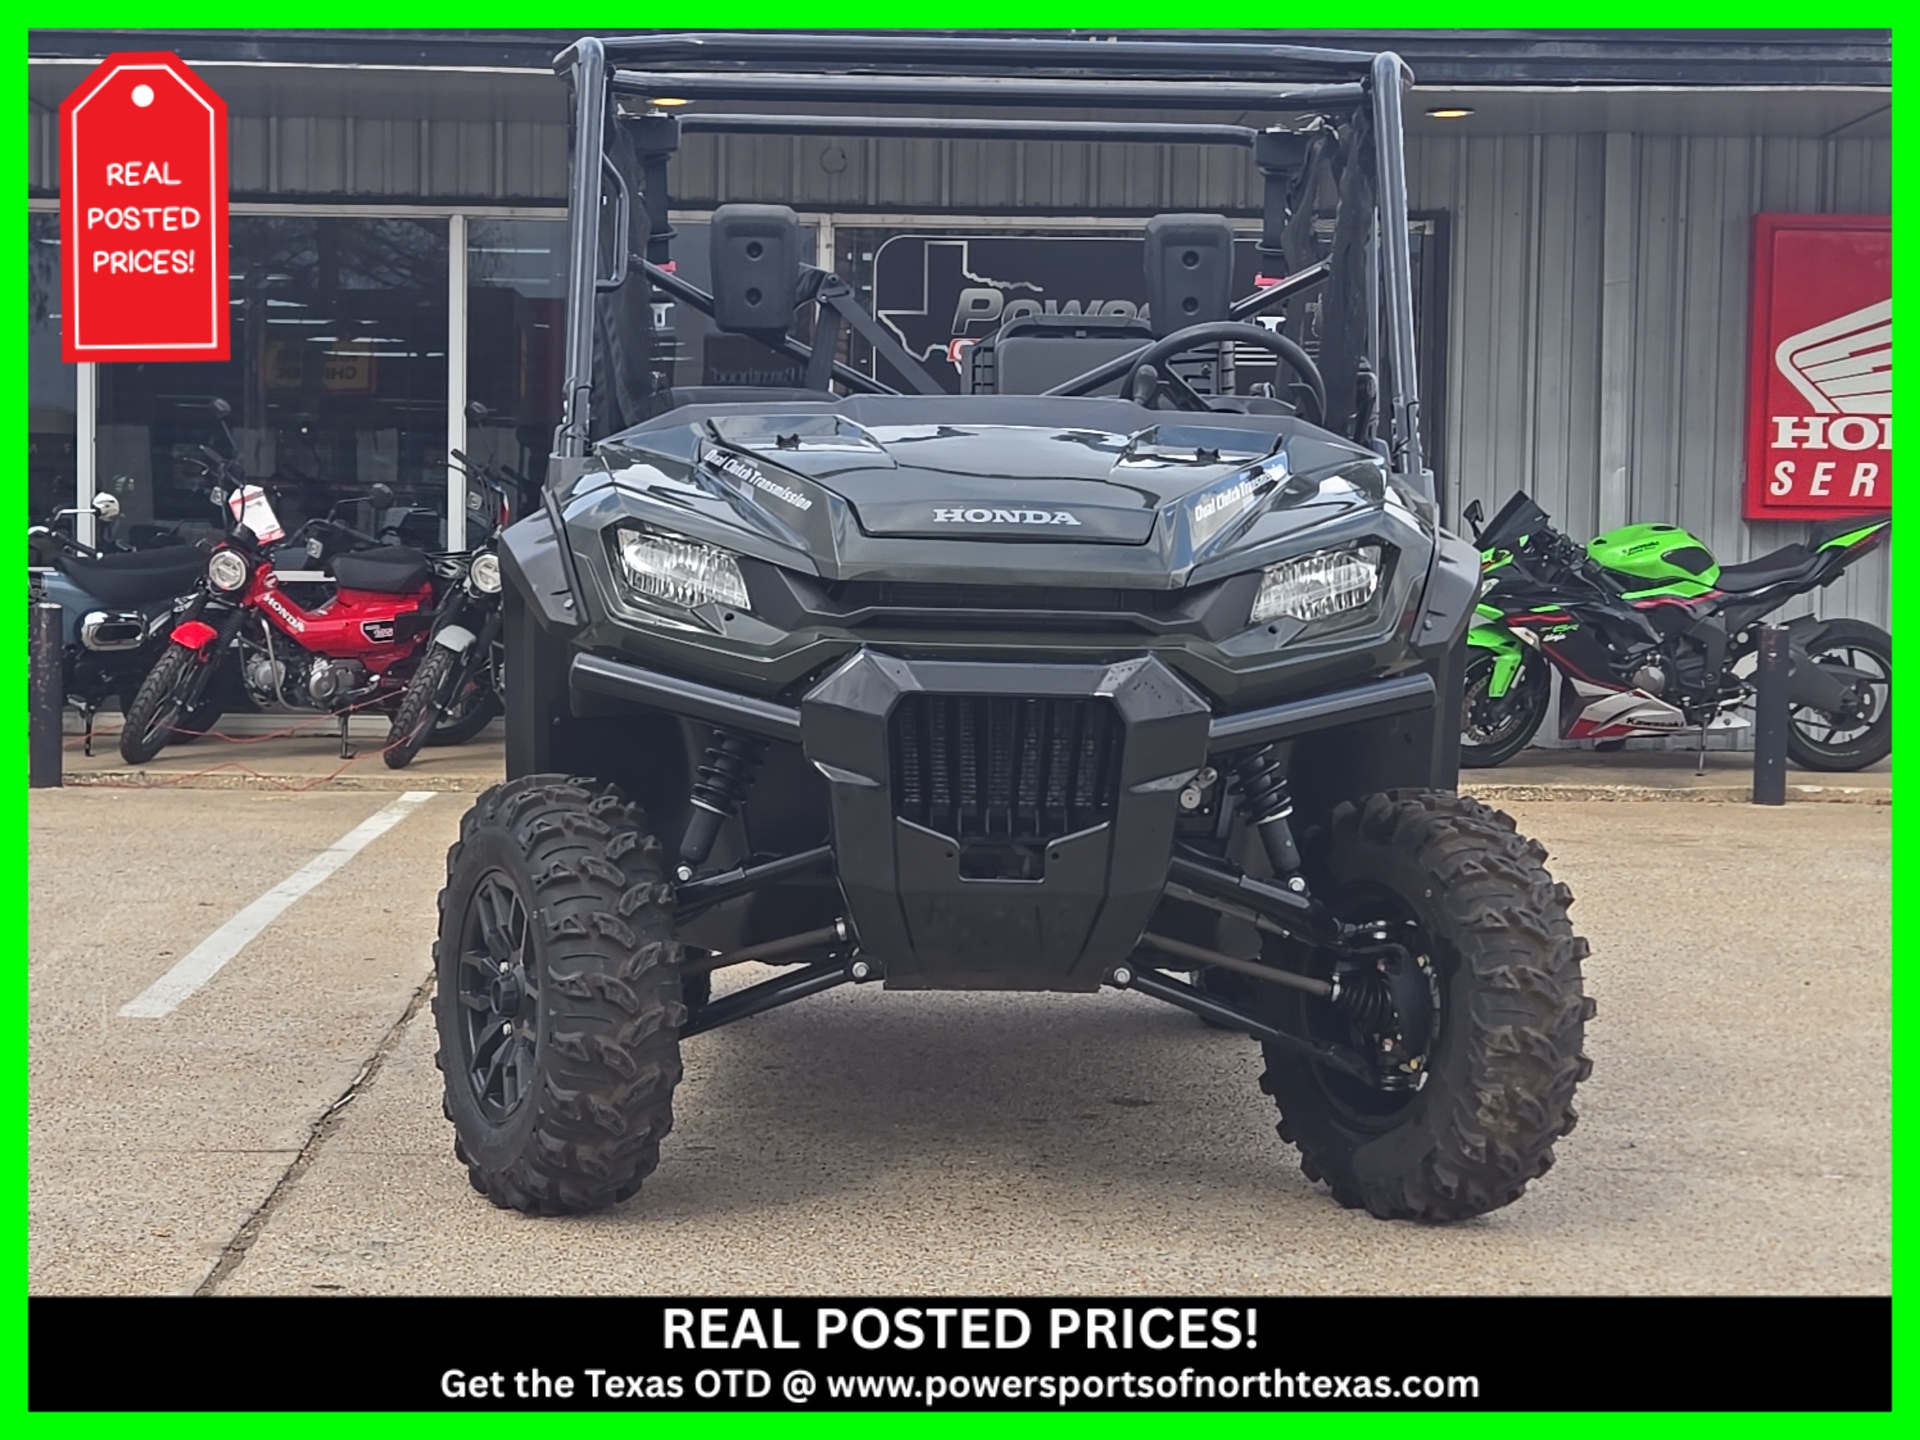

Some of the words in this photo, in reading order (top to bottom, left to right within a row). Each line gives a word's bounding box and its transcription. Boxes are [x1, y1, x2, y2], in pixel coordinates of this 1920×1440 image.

[1771, 416, 1892, 451] HO
[703, 448, 728, 467] Dual
[748, 470, 813, 511] Transmission
[1194, 497, 1216, 522] Dual
[1239, 464, 1287, 497] Transmis
[932, 507, 1081, 526] HONDA
[262, 592, 305, 633] HONDA
[1626, 717, 1684, 728] Kawasaki
